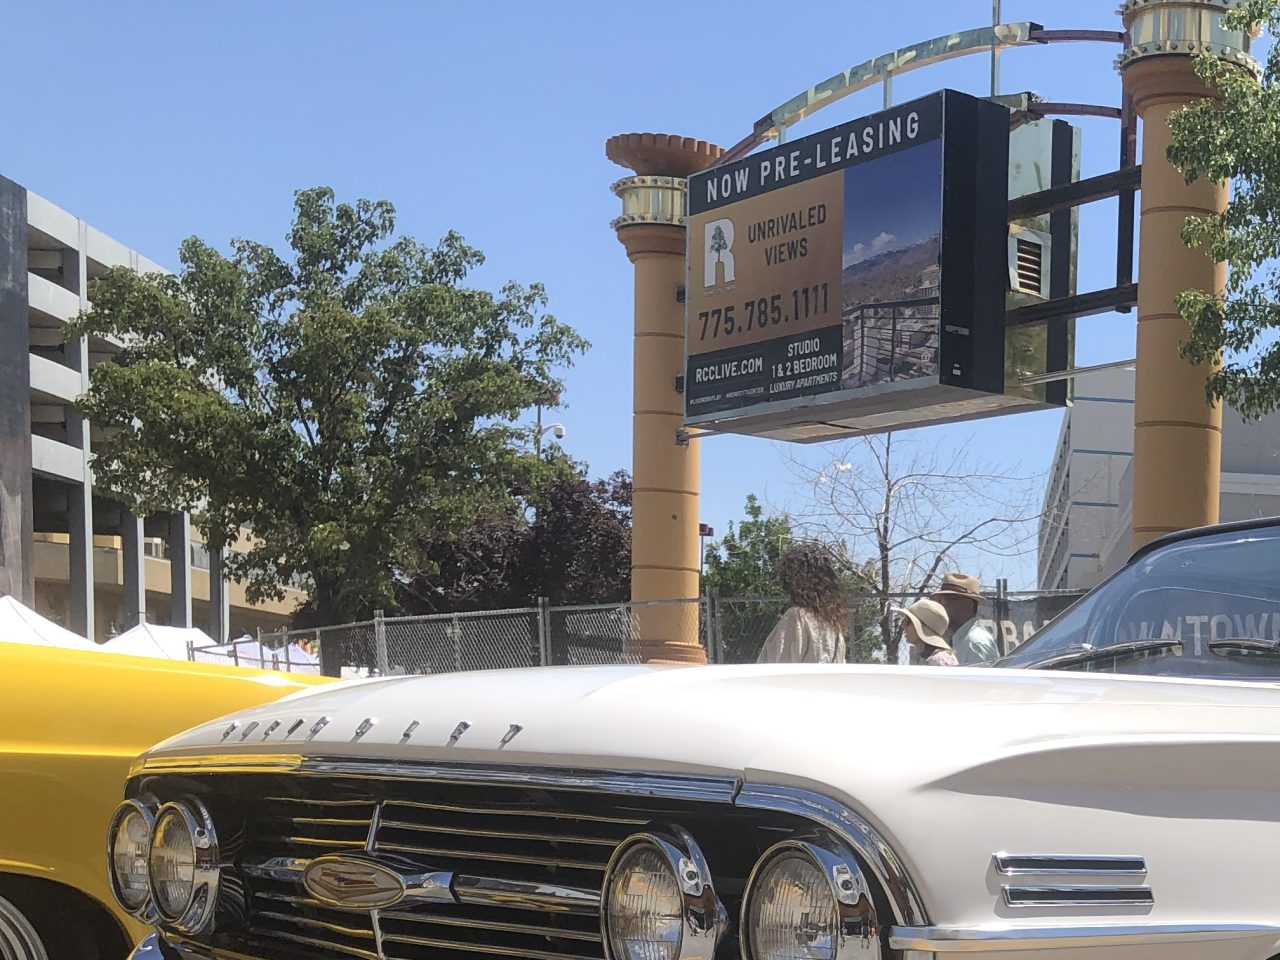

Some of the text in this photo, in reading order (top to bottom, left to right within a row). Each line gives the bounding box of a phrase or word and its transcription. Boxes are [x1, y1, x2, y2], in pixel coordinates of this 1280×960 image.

[706, 111, 919, 203] NOW PRE-LEASING
[748, 203, 827, 244] UNRIVALED
[765, 237, 808, 267] VIEWS
[699, 282, 829, 341] 775.785.1111
[787, 337, 820, 357] STUDIO
[695, 357, 763, 384] RCCLIVE.COM
[771, 353, 837, 379] 1 & 2 BEDROOM
[769, 371, 838, 393] LUXURY APARTMENTS
